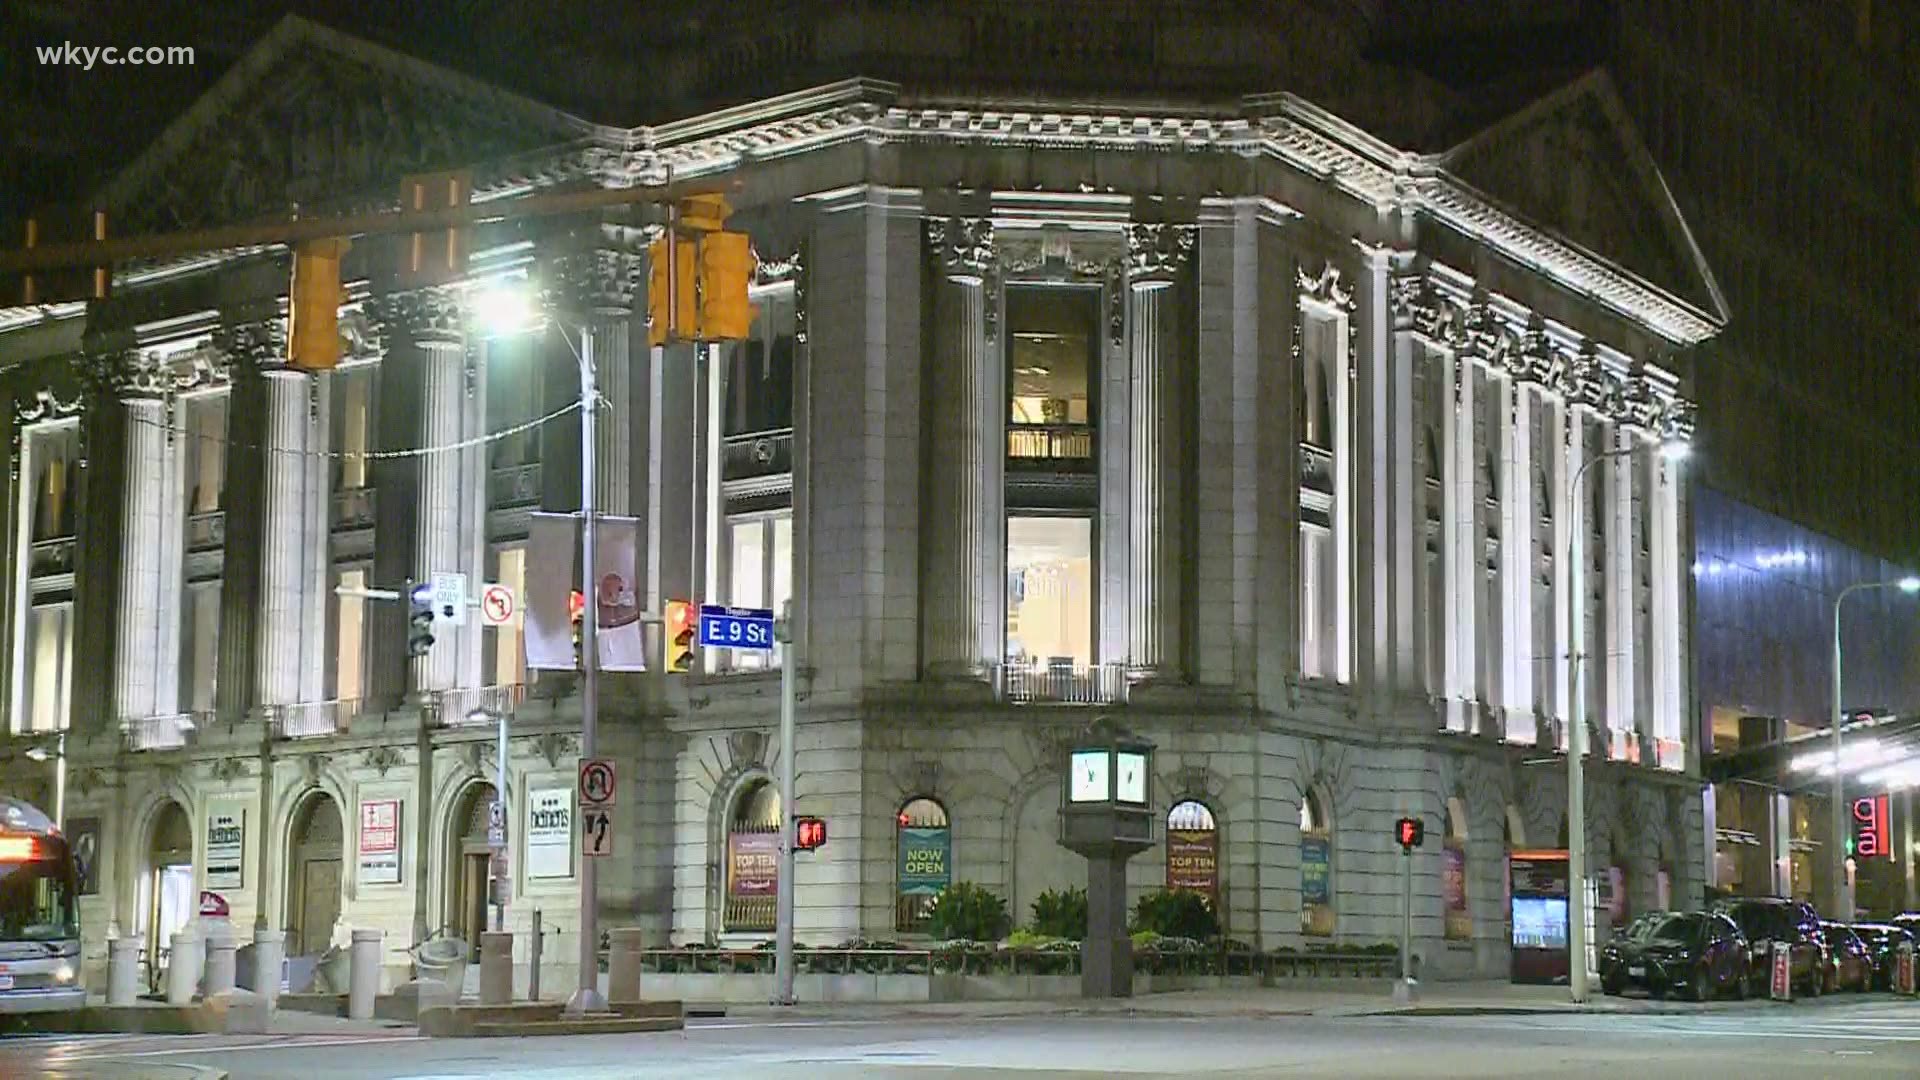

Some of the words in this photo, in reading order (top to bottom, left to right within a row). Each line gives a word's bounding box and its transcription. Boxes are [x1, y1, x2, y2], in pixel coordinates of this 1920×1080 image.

[439, 577, 457, 590] BUS
[436, 591, 459, 603] ONLY
[709, 620, 725, 640] E.
[729, 621, 742, 641] 9
[746, 623, 767, 643] St
[736, 855, 754, 867] TOP
[757, 855, 776, 866] TEN
[907, 849, 943, 861] NOW
[905, 861, 944, 873] OPEN
[1171, 857, 1191, 866] TOP
[1194, 857, 1215, 867] TEN
